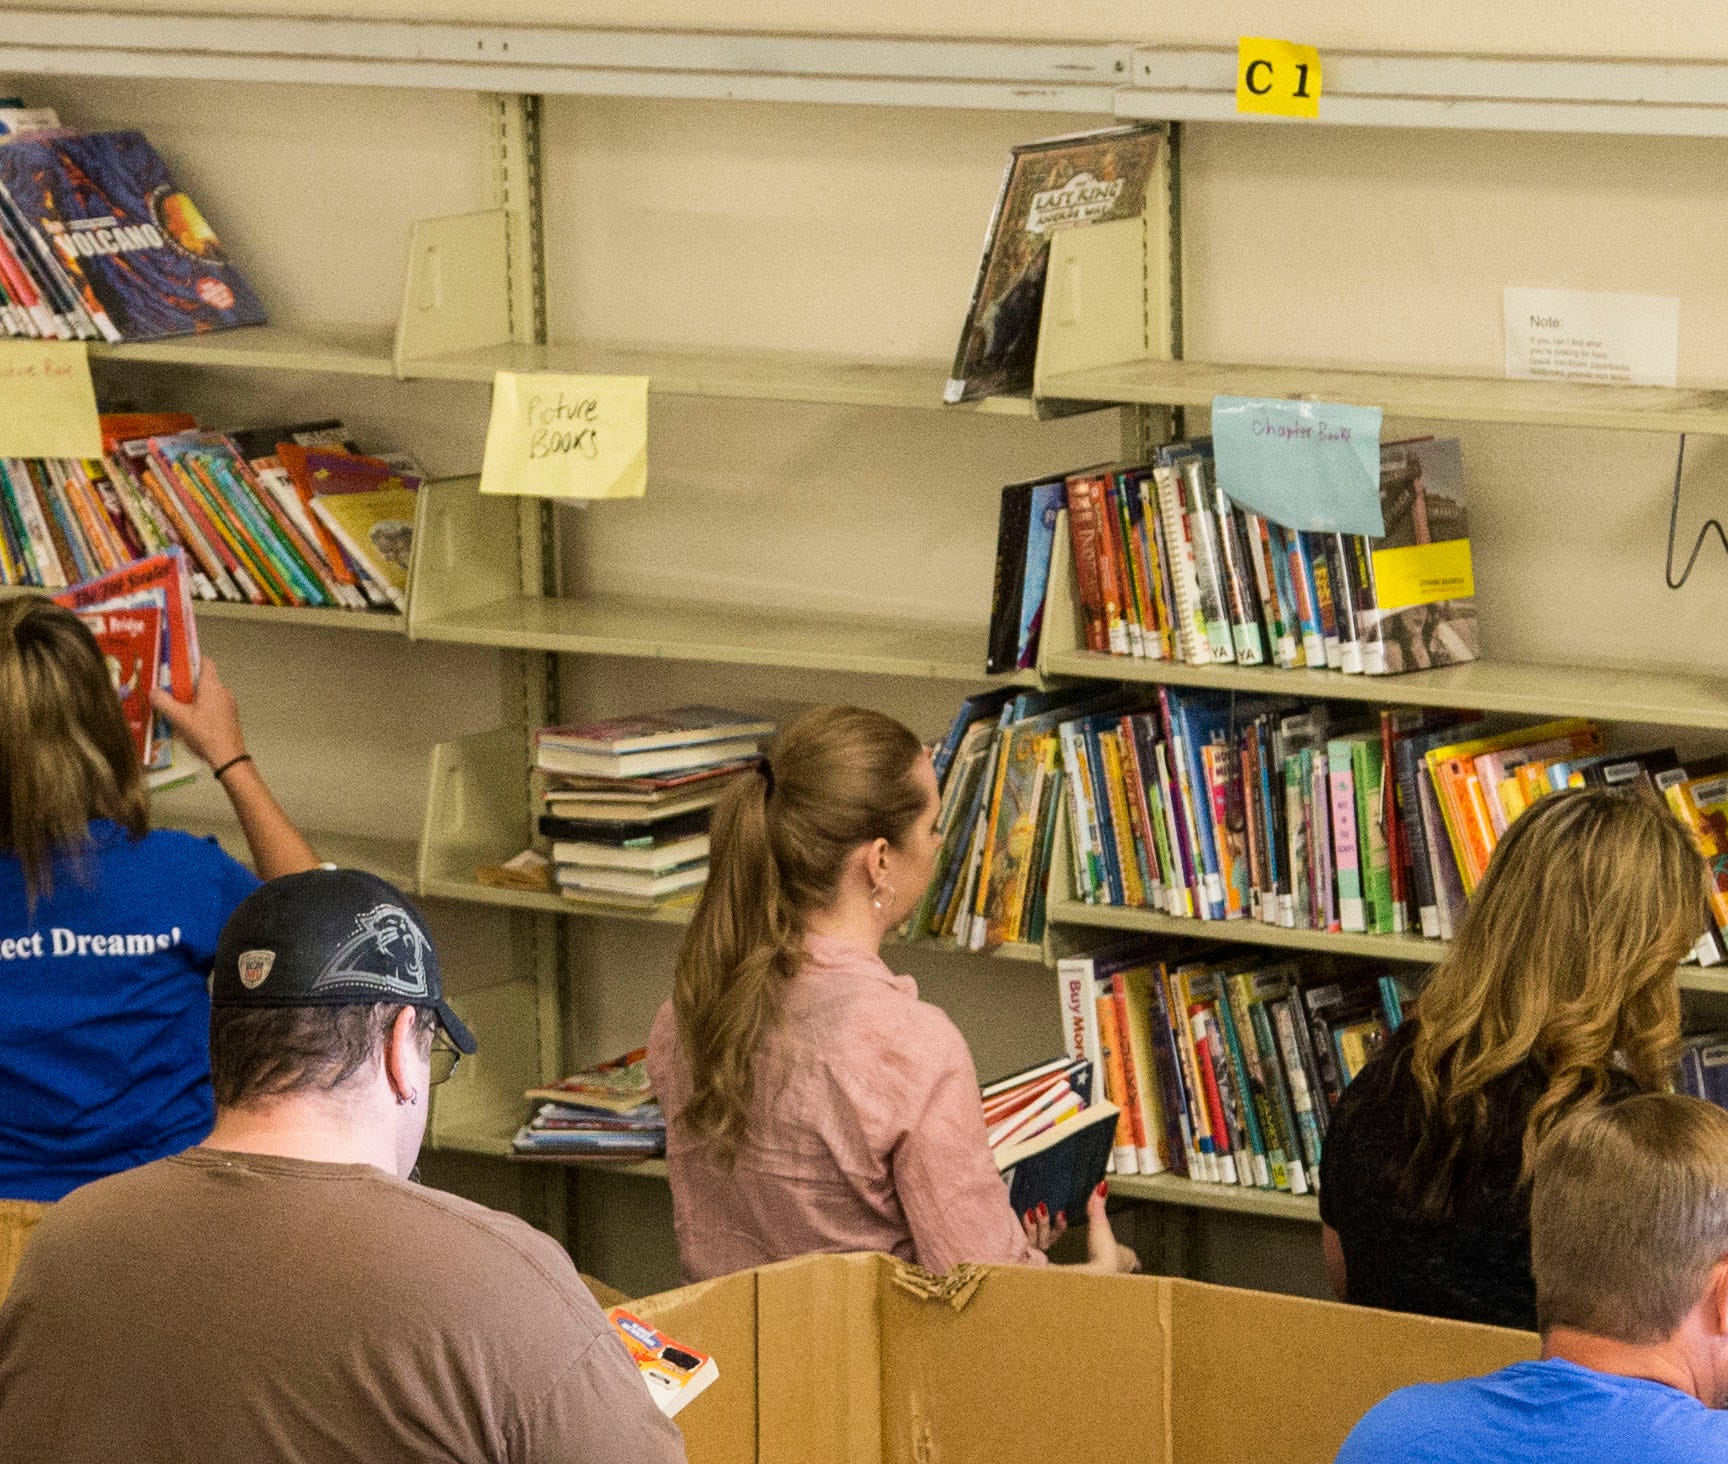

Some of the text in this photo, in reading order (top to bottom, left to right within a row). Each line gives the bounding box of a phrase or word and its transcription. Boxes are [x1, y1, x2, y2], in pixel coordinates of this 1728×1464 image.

[1244, 59, 1312, 97] C 1
[54, 223, 164, 258] VOLCANO
[51, 926, 182, 958] Dreams!
[1068, 979, 1088, 1061] Buy More
